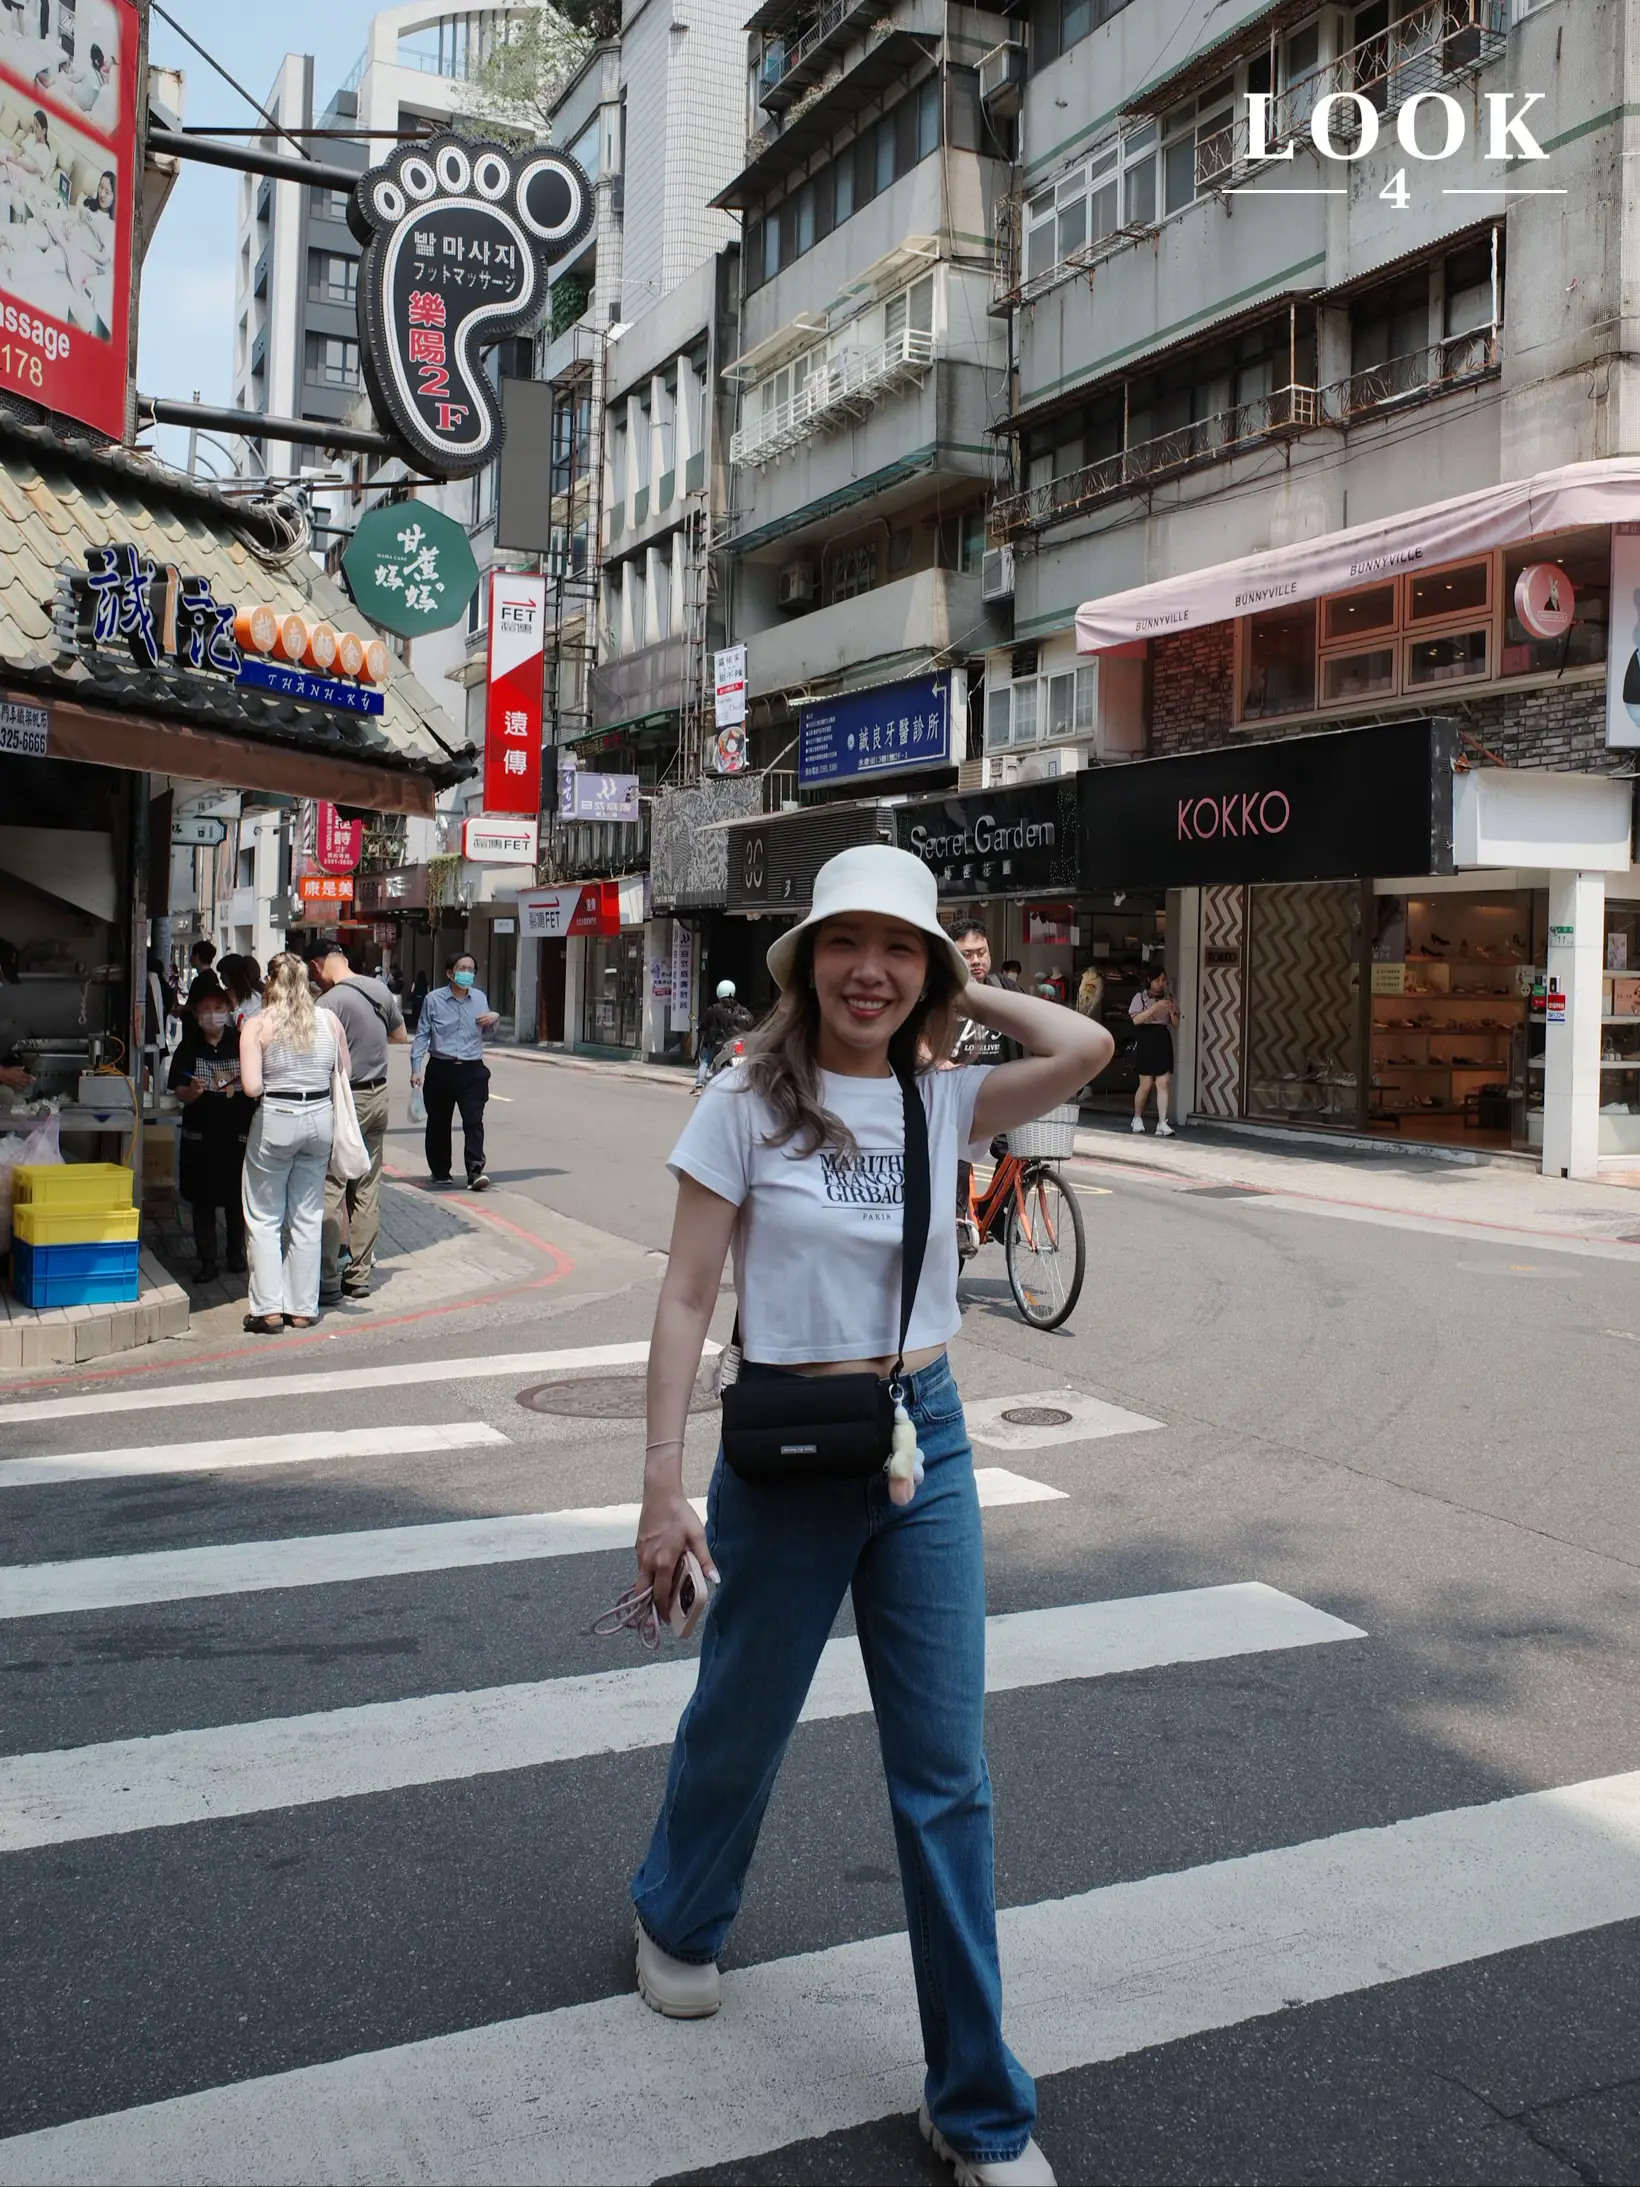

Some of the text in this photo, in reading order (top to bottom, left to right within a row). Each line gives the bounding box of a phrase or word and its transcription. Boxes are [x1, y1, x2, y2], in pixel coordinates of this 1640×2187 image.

[1349, 547, 1424, 577] BUNNYVILLE
[1235, 582, 1297, 607] BUNNYVILLE
[502, 608, 536, 623] FET
[1136, 609, 1189, 632] BUNNYVILLE
[503, 710, 529, 776] 遠傳
[858, 712, 940, 752] 誠良牙醫診所
[1178, 790, 1290, 841] KOKKO
[911, 815, 1055, 859] Secret Garden
[304, 880, 354, 897] 康是美
[862, 1213, 891, 1221] PARIS
